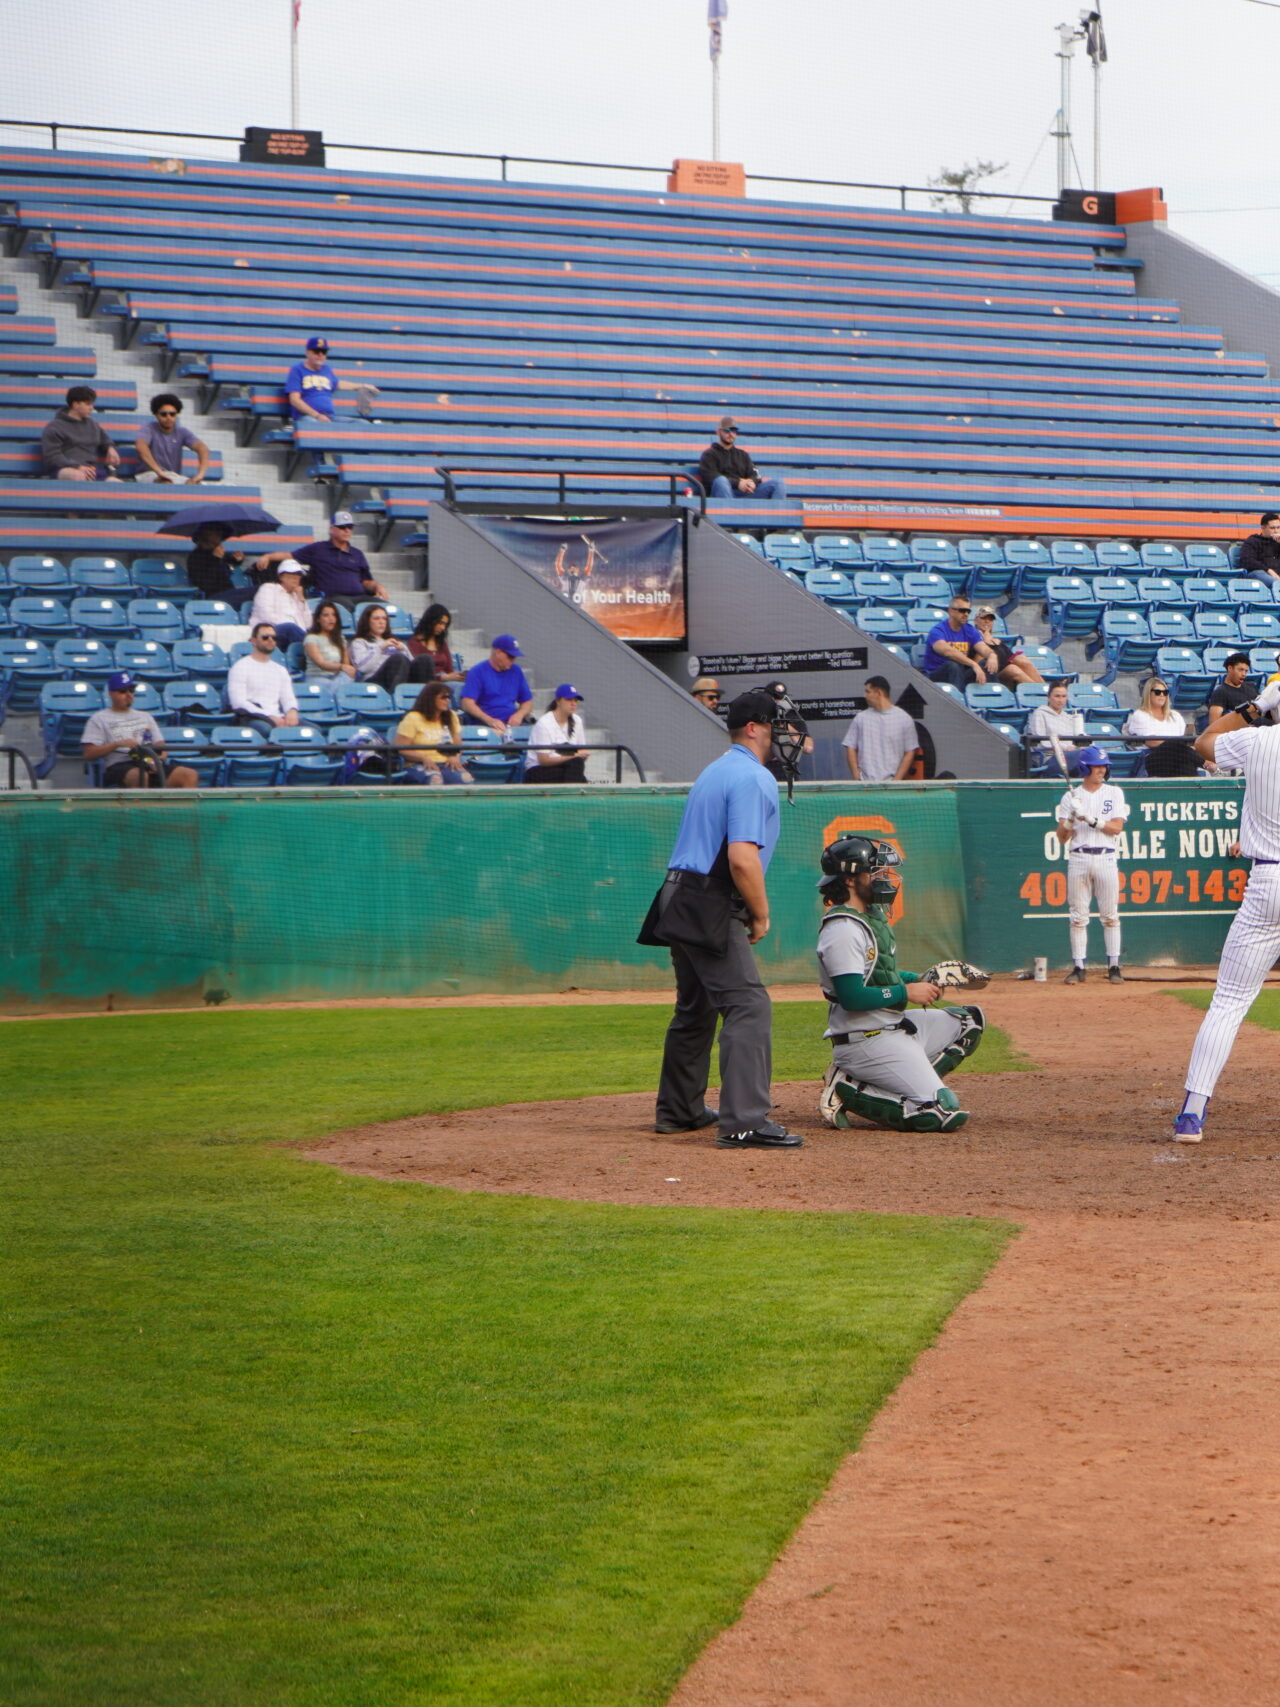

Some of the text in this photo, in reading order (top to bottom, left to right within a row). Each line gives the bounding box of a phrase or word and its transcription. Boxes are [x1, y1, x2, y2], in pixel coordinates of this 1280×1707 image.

[1082, 196, 1099, 215] G
[573, 589, 672, 604] of Your Health
[1141, 801, 1238, 821] TICKETS
[1116, 829, 1166, 860] ALE
[1179, 828, 1240, 858] NOW
[1019, 872, 1067, 907] 40
